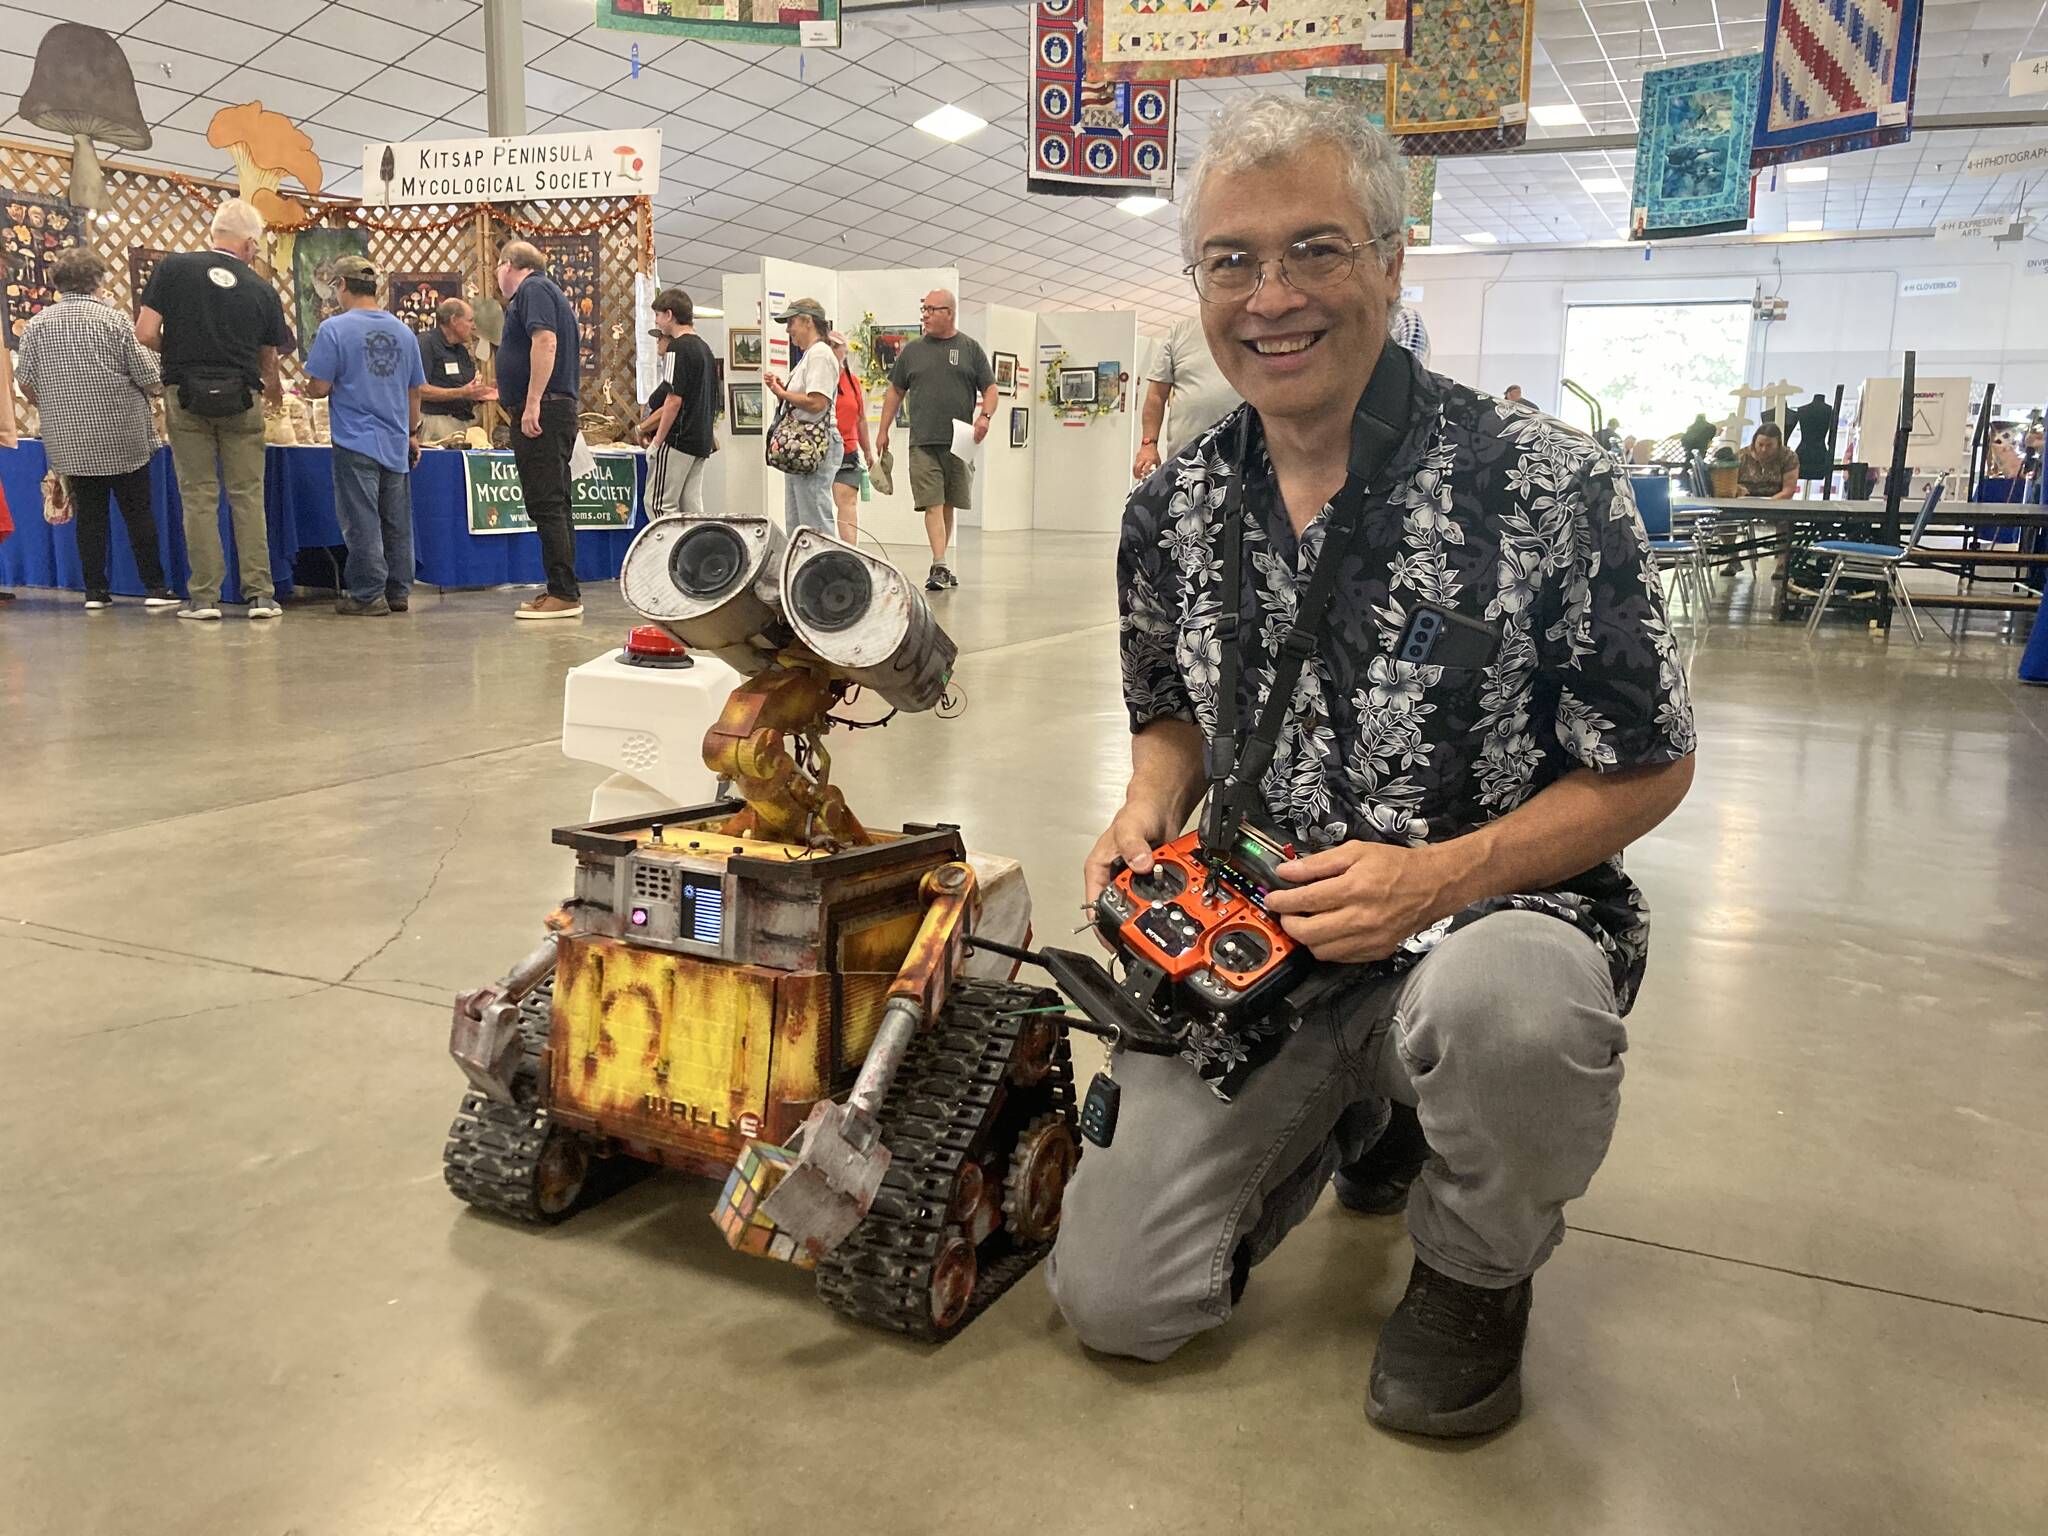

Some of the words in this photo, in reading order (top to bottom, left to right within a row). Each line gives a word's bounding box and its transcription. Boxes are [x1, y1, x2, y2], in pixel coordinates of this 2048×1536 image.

[419, 148, 485, 170] KITSAP
[493, 144, 593, 167] PENINSULA
[401, 175, 526, 198] MYCOLOGICAL
[535, 169, 613, 191] SOCIETY
[1961, 228, 1982, 238] ARTS
[490, 461, 518, 480] KIT
[475, 482, 523, 502] MYCO
[577, 482, 632, 501] SOCIETY
[571, 511, 612, 522] ooms.org
